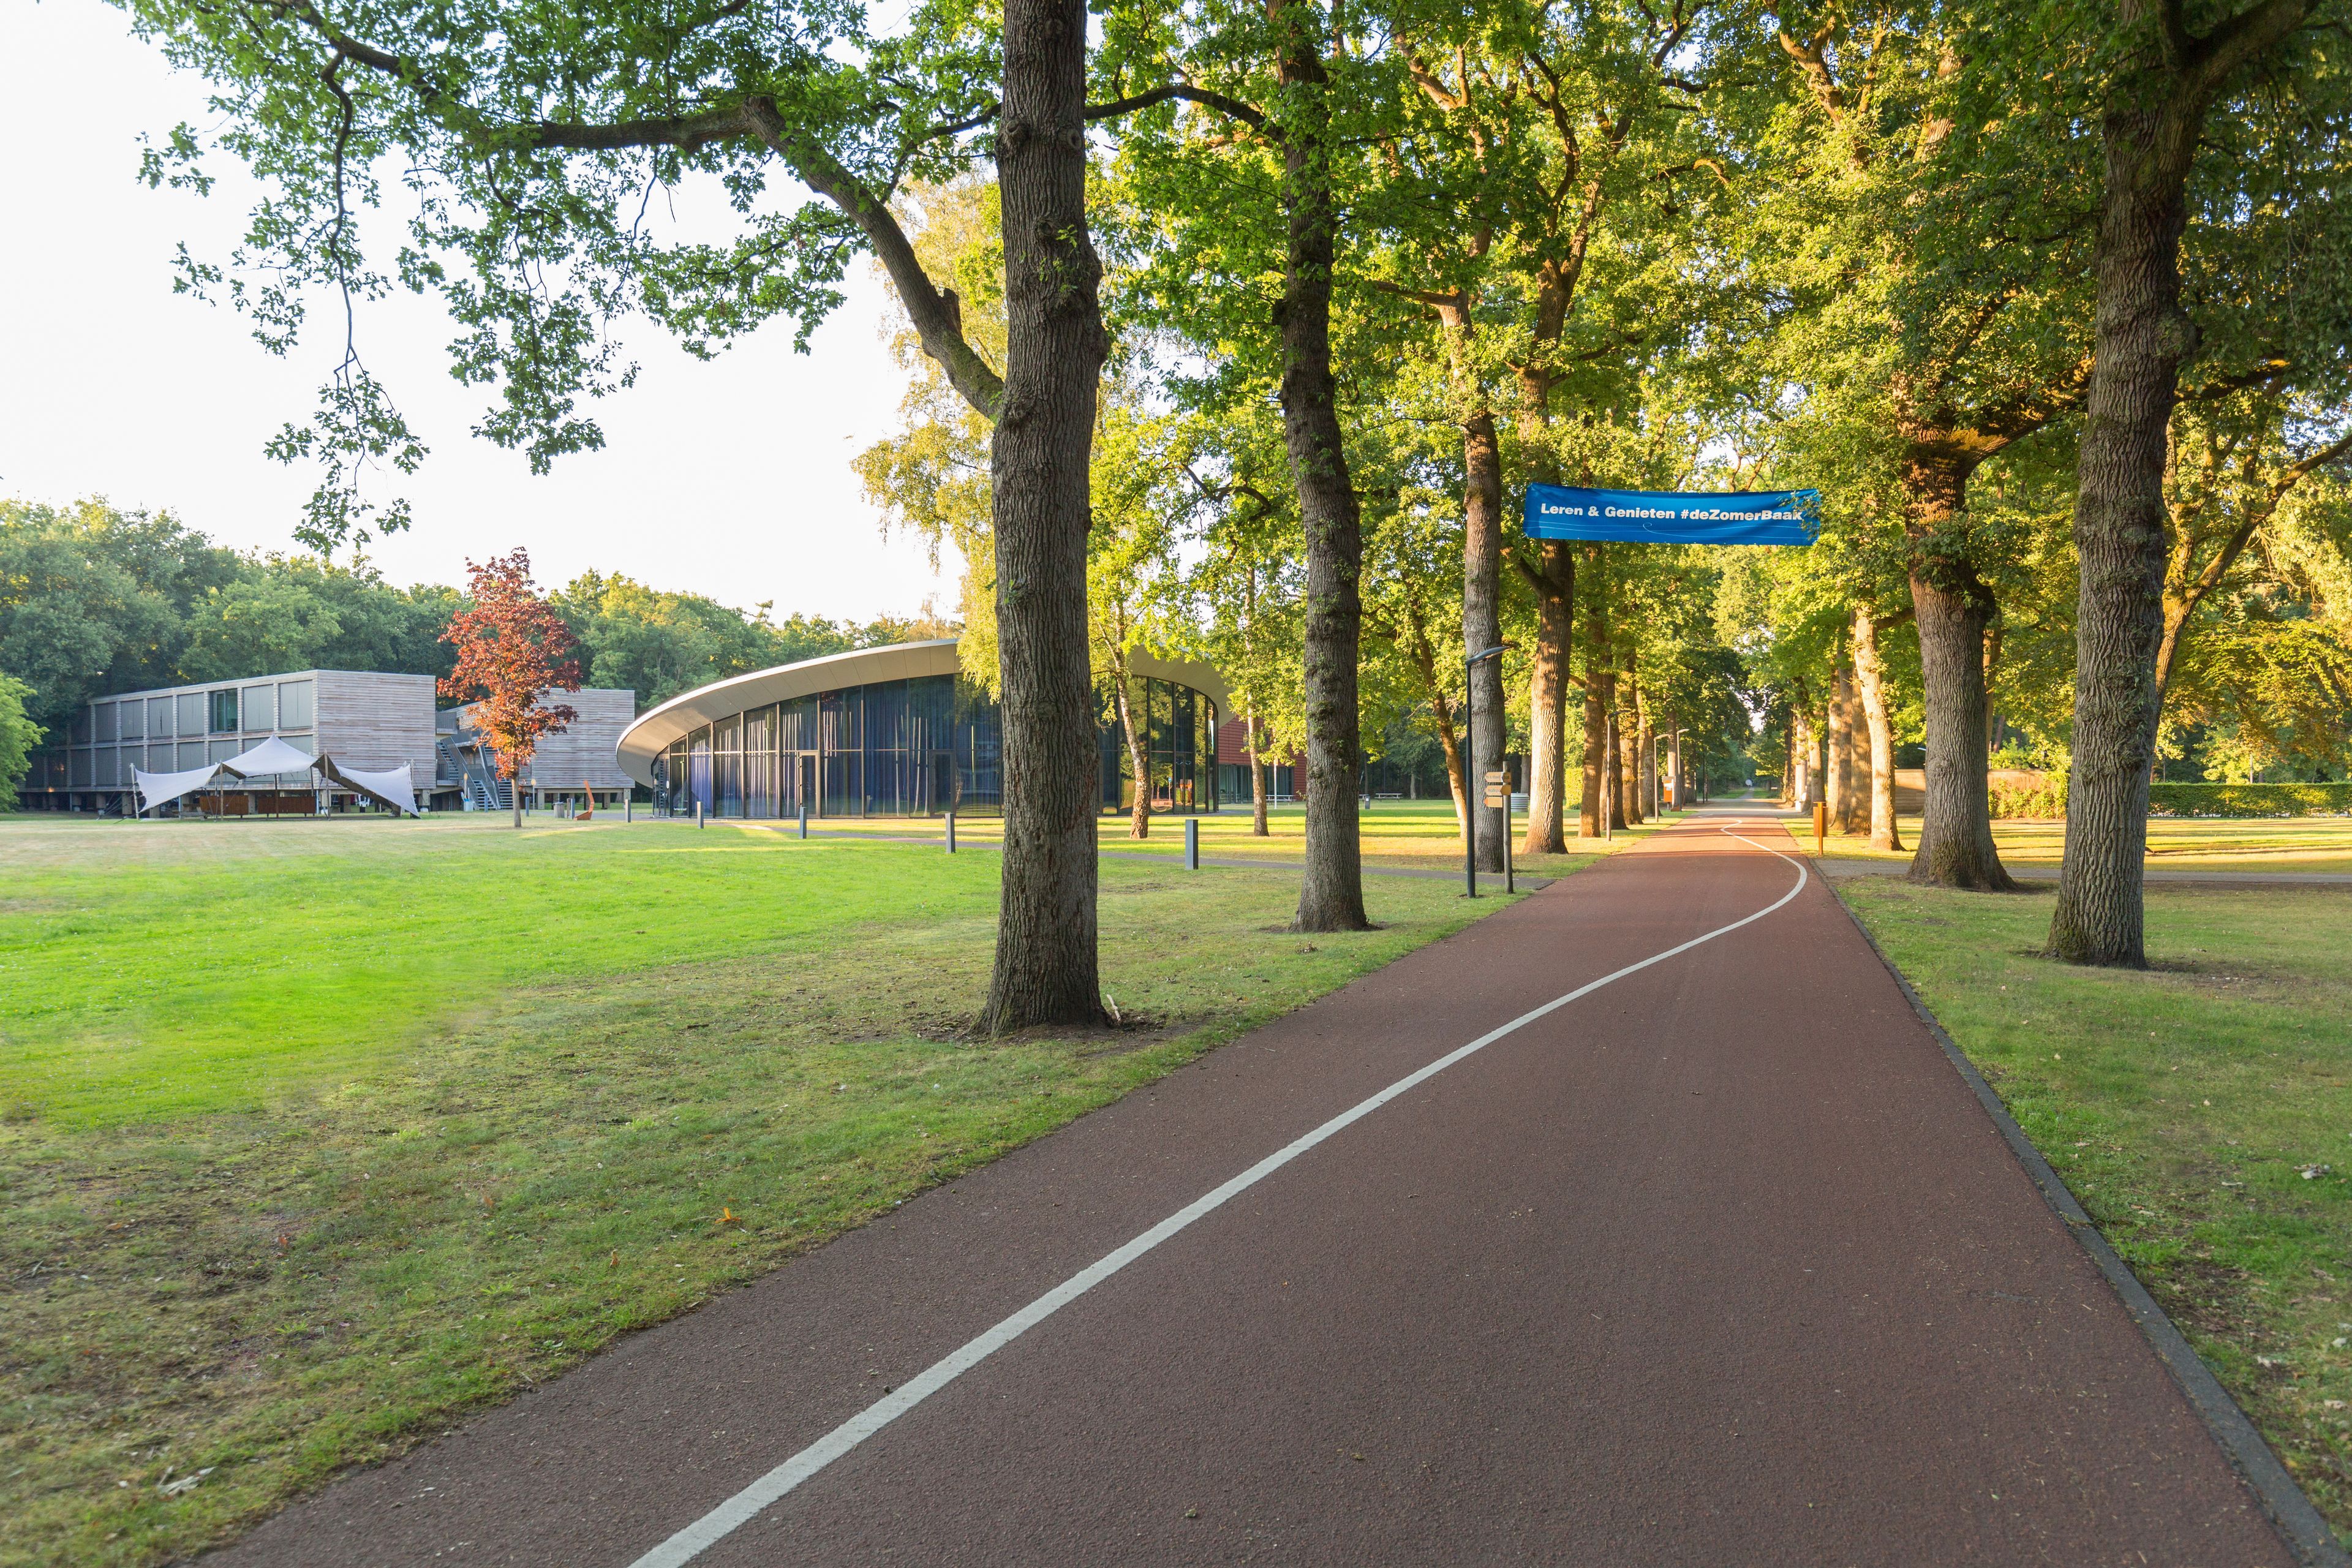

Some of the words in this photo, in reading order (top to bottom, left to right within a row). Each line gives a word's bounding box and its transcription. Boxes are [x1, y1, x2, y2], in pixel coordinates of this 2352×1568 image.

[1540, 503, 1583, 516] Leren
[1588, 506, 1599, 517] &
[1605, 507, 1675, 519] Genieten
[1681, 509, 1803, 521] #deZomerBaak
